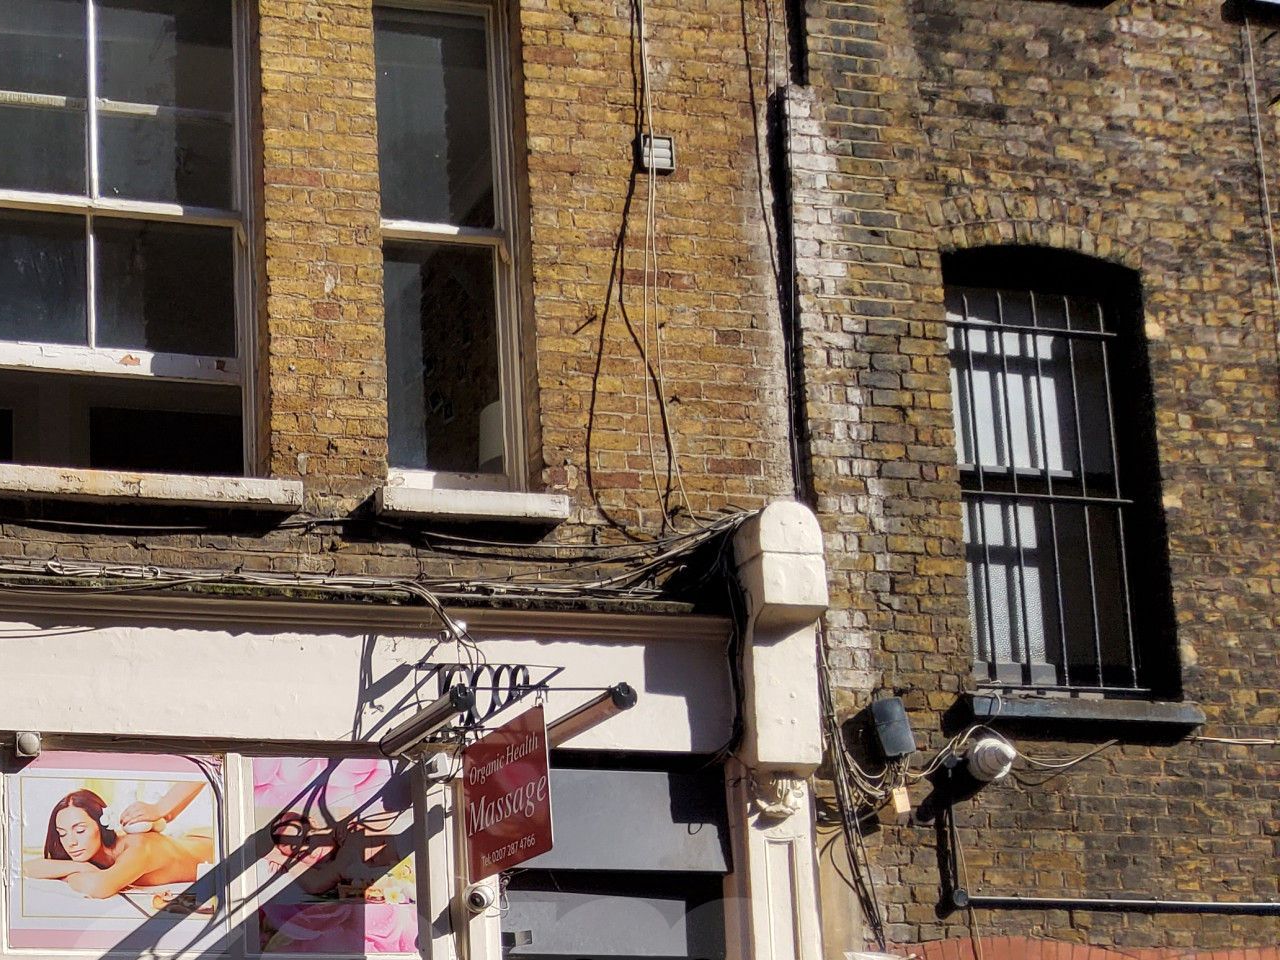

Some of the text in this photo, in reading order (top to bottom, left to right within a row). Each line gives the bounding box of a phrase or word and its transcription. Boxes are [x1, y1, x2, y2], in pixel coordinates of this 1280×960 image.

[469, 731, 538, 786] Organic Health
[468, 775, 547, 837] Massage
[507, 840, 519, 857] 287
[519, 833, 536, 850] 4766
